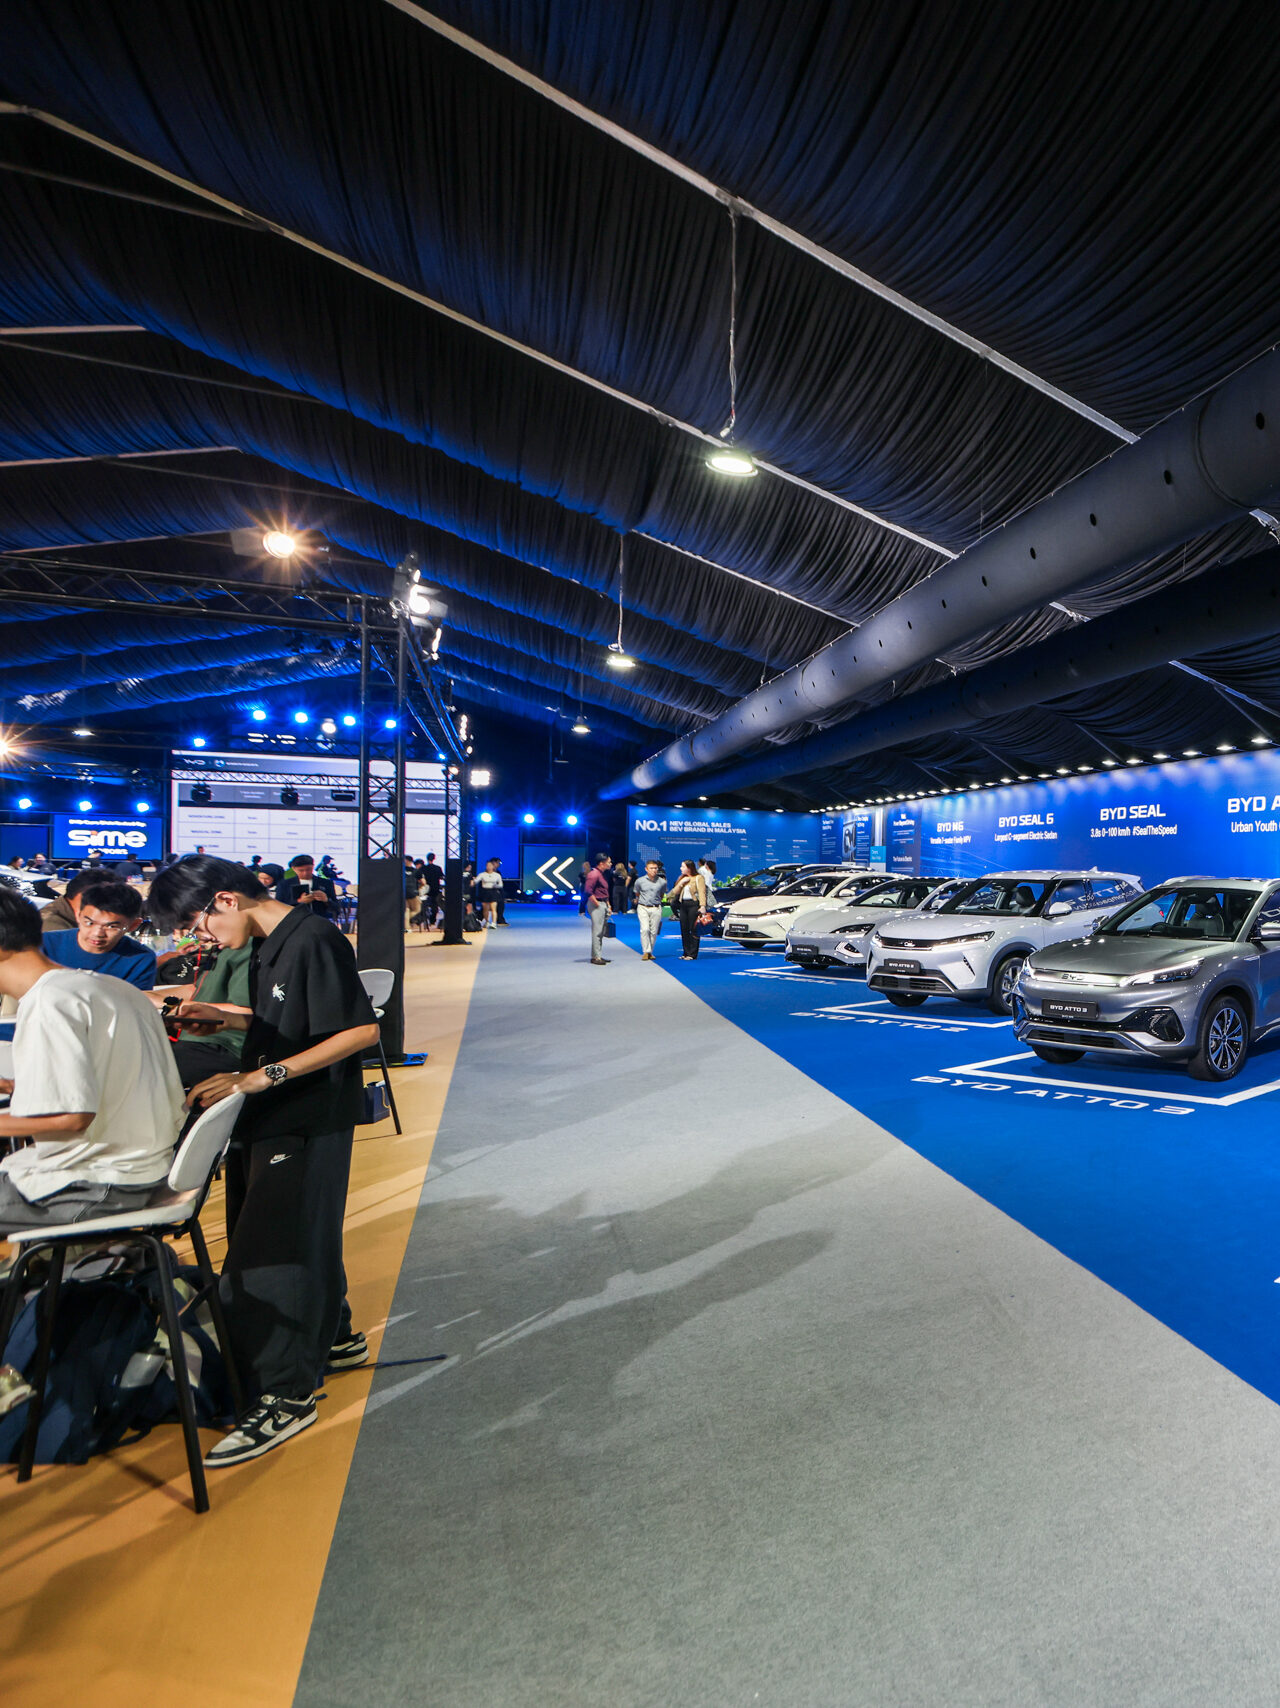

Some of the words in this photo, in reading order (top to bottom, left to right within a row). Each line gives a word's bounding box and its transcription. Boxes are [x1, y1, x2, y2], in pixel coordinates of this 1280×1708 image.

[1100, 807, 1127, 821] BYD
[1129, 804, 1166, 819] SEAL
[1227, 796, 1266, 813] BYD
[635, 819, 667, 832] NO.1
[999, 816, 1018, 828] BYD
[1019, 814, 1044, 826] SEAL
[1046, 813, 1054, 825] 6
[1231, 821, 1253, 833] Urban
[1255, 820, 1278, 832] Youth
[68, 830, 147, 848] sime
[910, 1075, 1012, 1091] BYD
[1014, 1089, 1150, 1110] ATTO
[1152, 1105, 1196, 1115] 3
